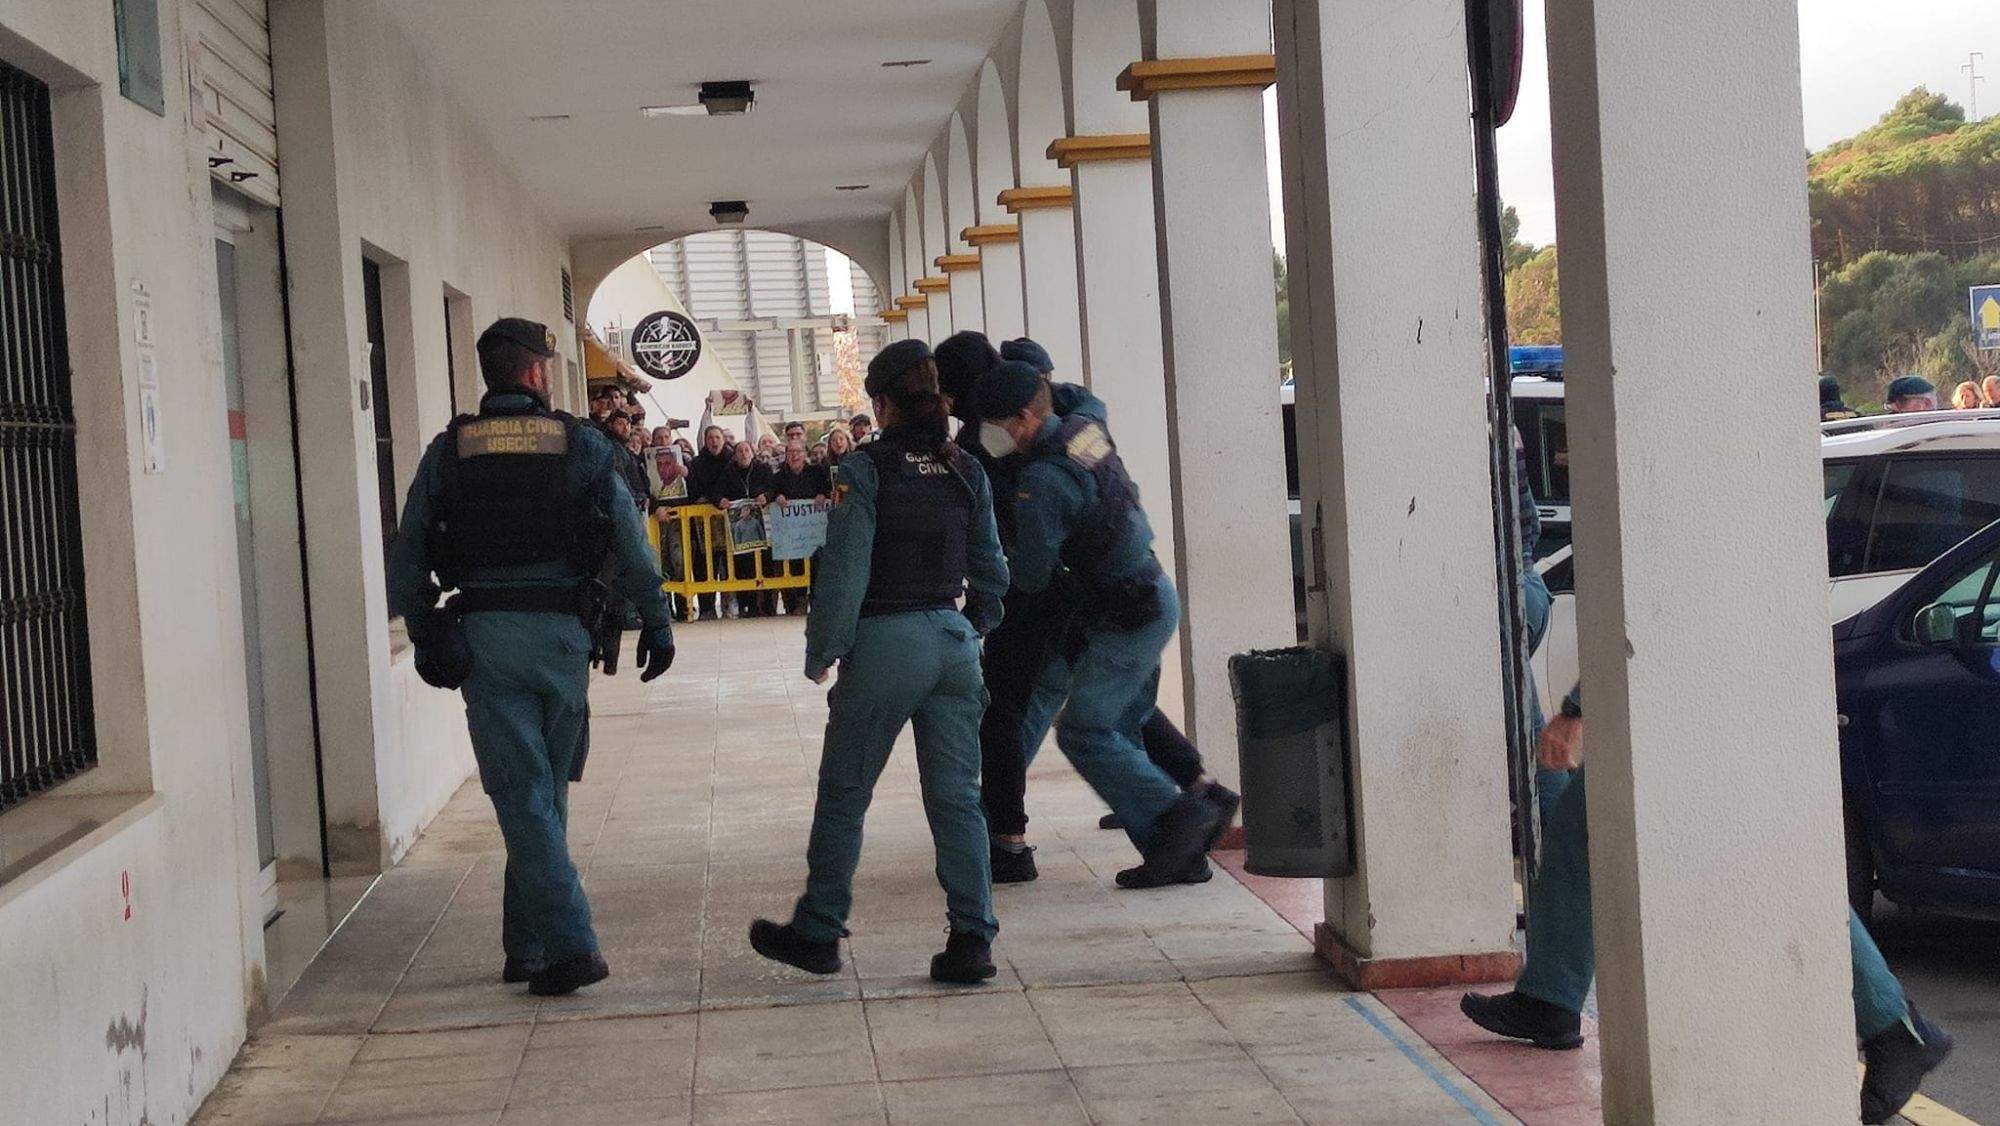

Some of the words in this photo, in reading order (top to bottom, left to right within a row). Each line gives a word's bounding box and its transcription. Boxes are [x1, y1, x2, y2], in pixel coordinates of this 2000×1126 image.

[463, 420, 523, 437] GUARDIA
[526, 419, 562, 436] CIVIL
[487, 436, 538, 453] USECIC
[918, 463, 949, 475] CIVIL
